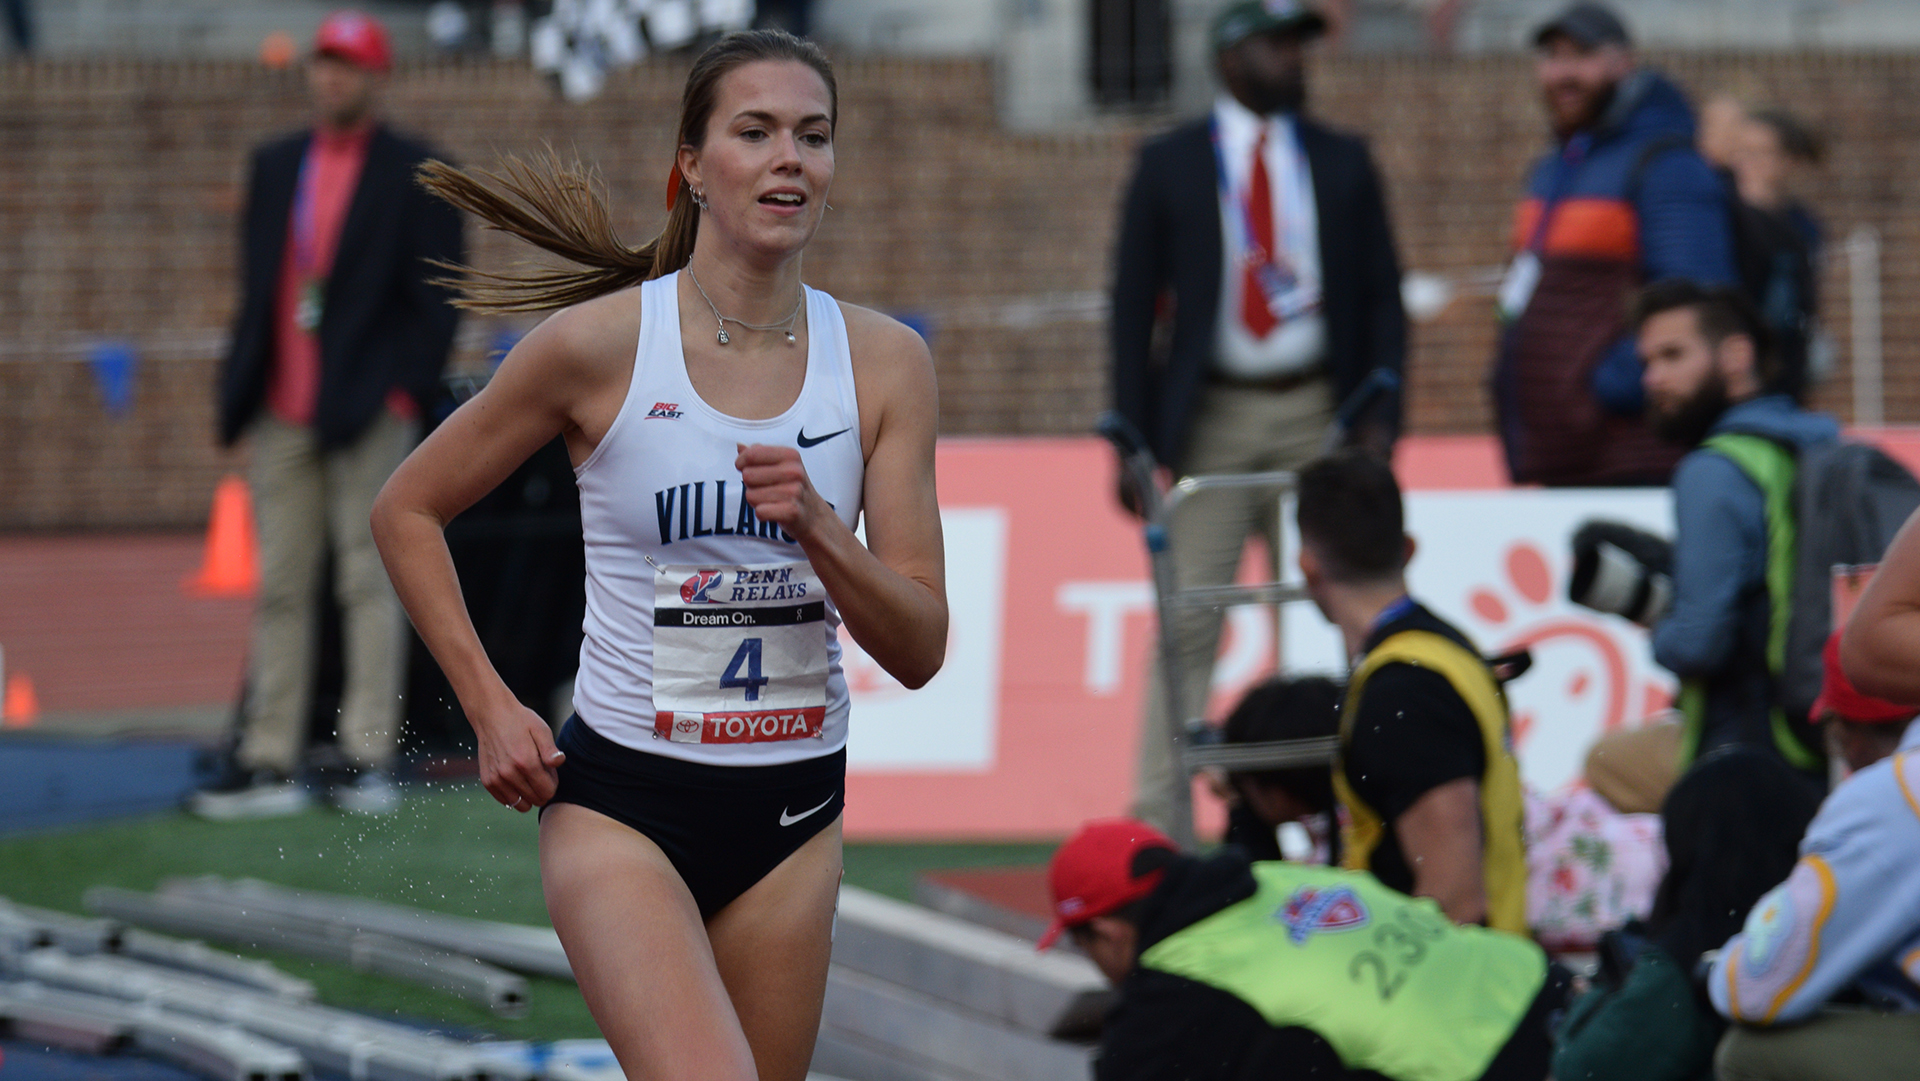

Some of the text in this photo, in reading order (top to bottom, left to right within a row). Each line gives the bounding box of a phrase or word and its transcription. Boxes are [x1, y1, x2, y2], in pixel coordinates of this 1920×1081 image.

[647, 409, 684, 419] EAST
[652, 402, 679, 411] BIG
[655, 480, 836, 546] VILLA
[734, 568, 793, 585] PENN
[730, 583, 807, 602] RELAYS
[683, 612, 756, 625] Dream On.
[719, 637, 769, 702] 4
[710, 714, 808, 738] TOYOTA
